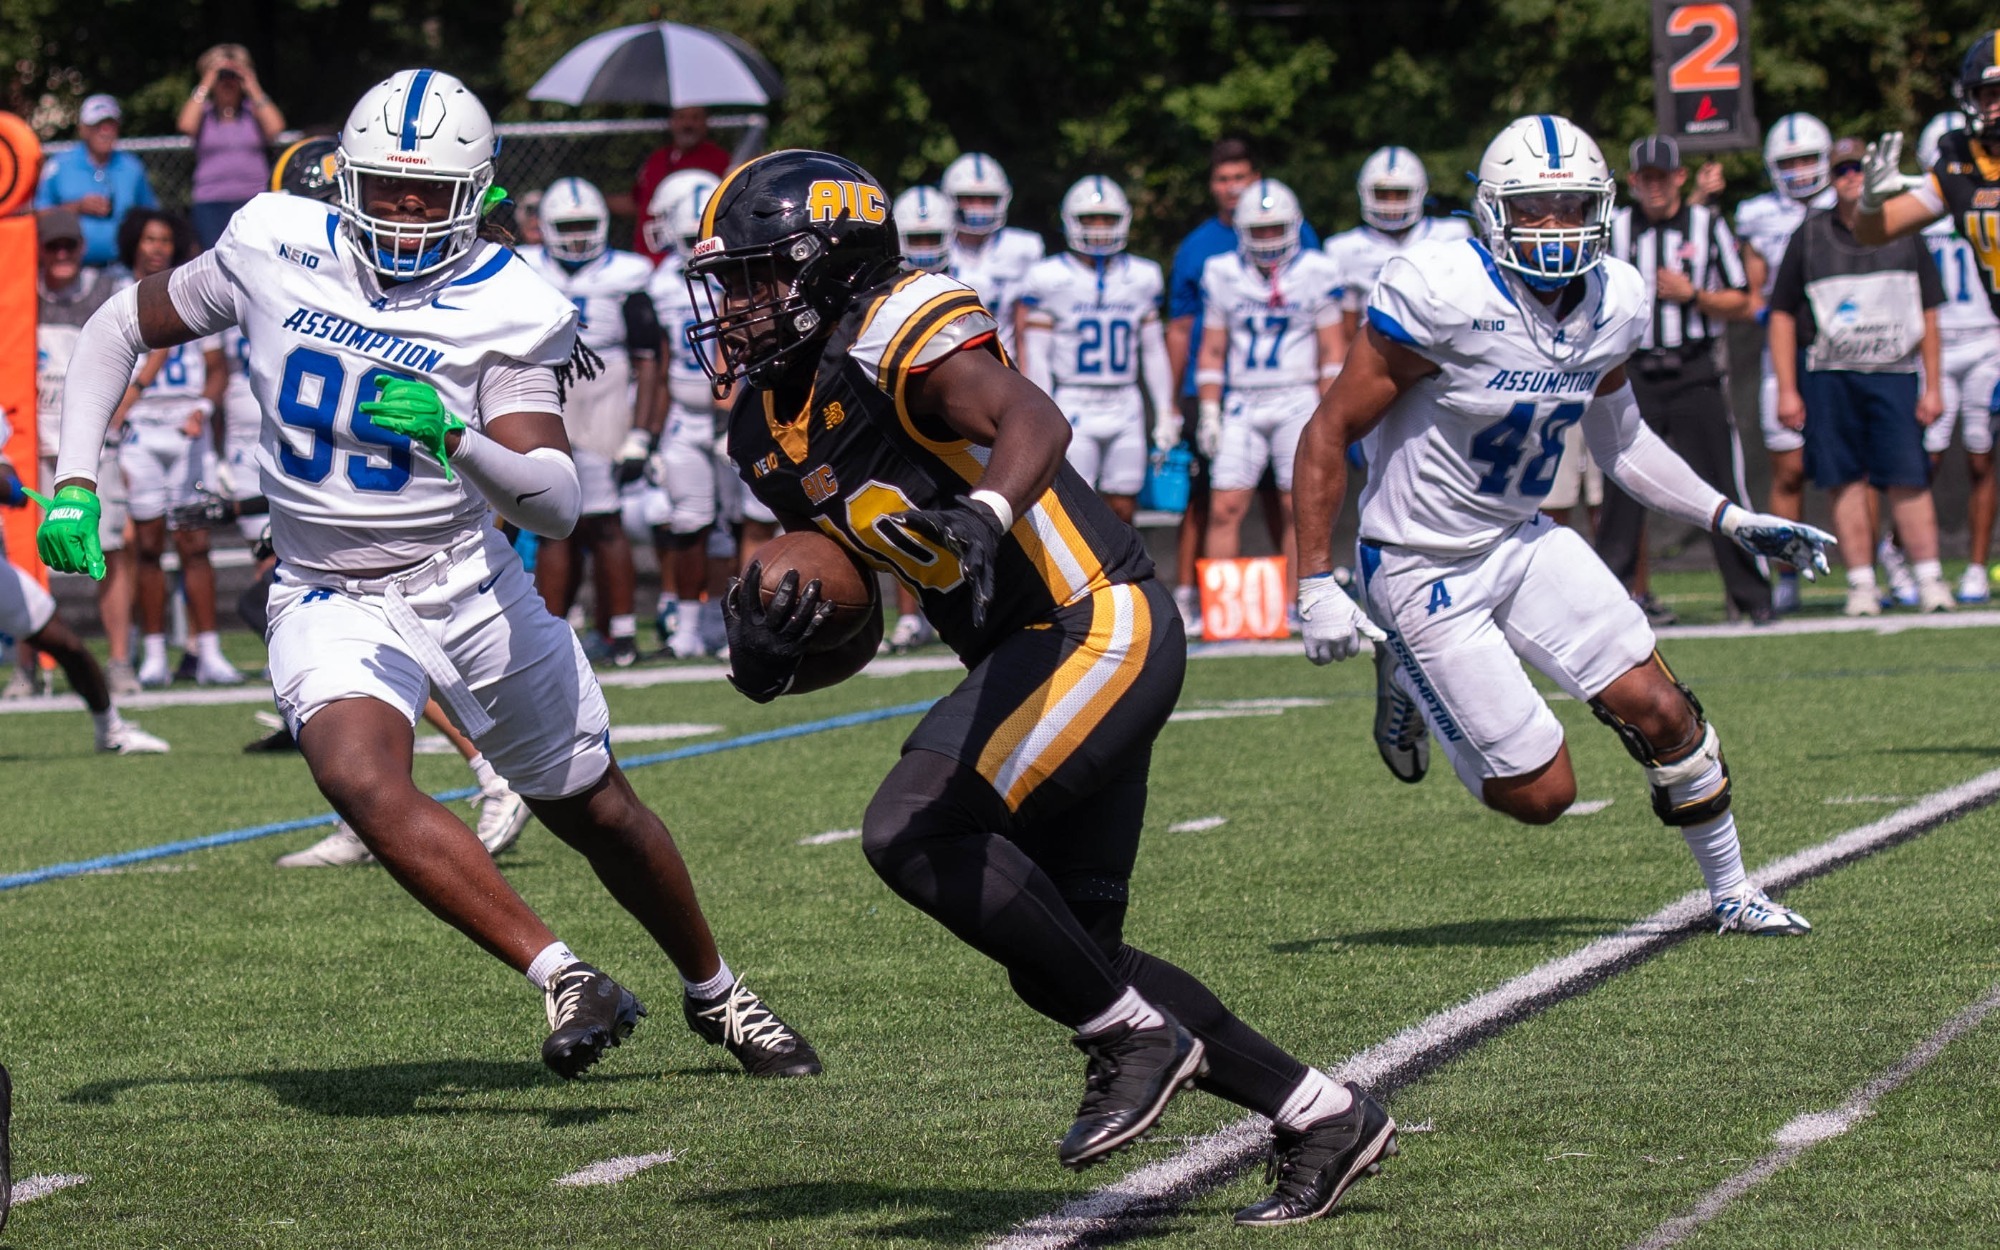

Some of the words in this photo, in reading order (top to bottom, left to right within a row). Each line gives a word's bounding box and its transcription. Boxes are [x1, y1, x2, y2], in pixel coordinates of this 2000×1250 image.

[1666, 3, 1740, 92] 2
[806, 179, 888, 225] AIC
[278, 243, 320, 270] NE10
[282, 307, 446, 373] ASSUMPTION
[1077, 318, 1132, 374] 20
[1246, 316, 1289, 369] 17
[1471, 318, 1505, 332] NE10
[1486, 369, 1601, 394] ASSUMPTION
[274, 343, 416, 493] 99
[752, 451, 779, 479] NE10
[1468, 399, 1587, 496] 48
[800, 463, 839, 506] AIC
[1204, 558, 1285, 638] 30
[1424, 580, 1452, 616] A
[1383, 627, 1463, 743] ASSUMPTION
